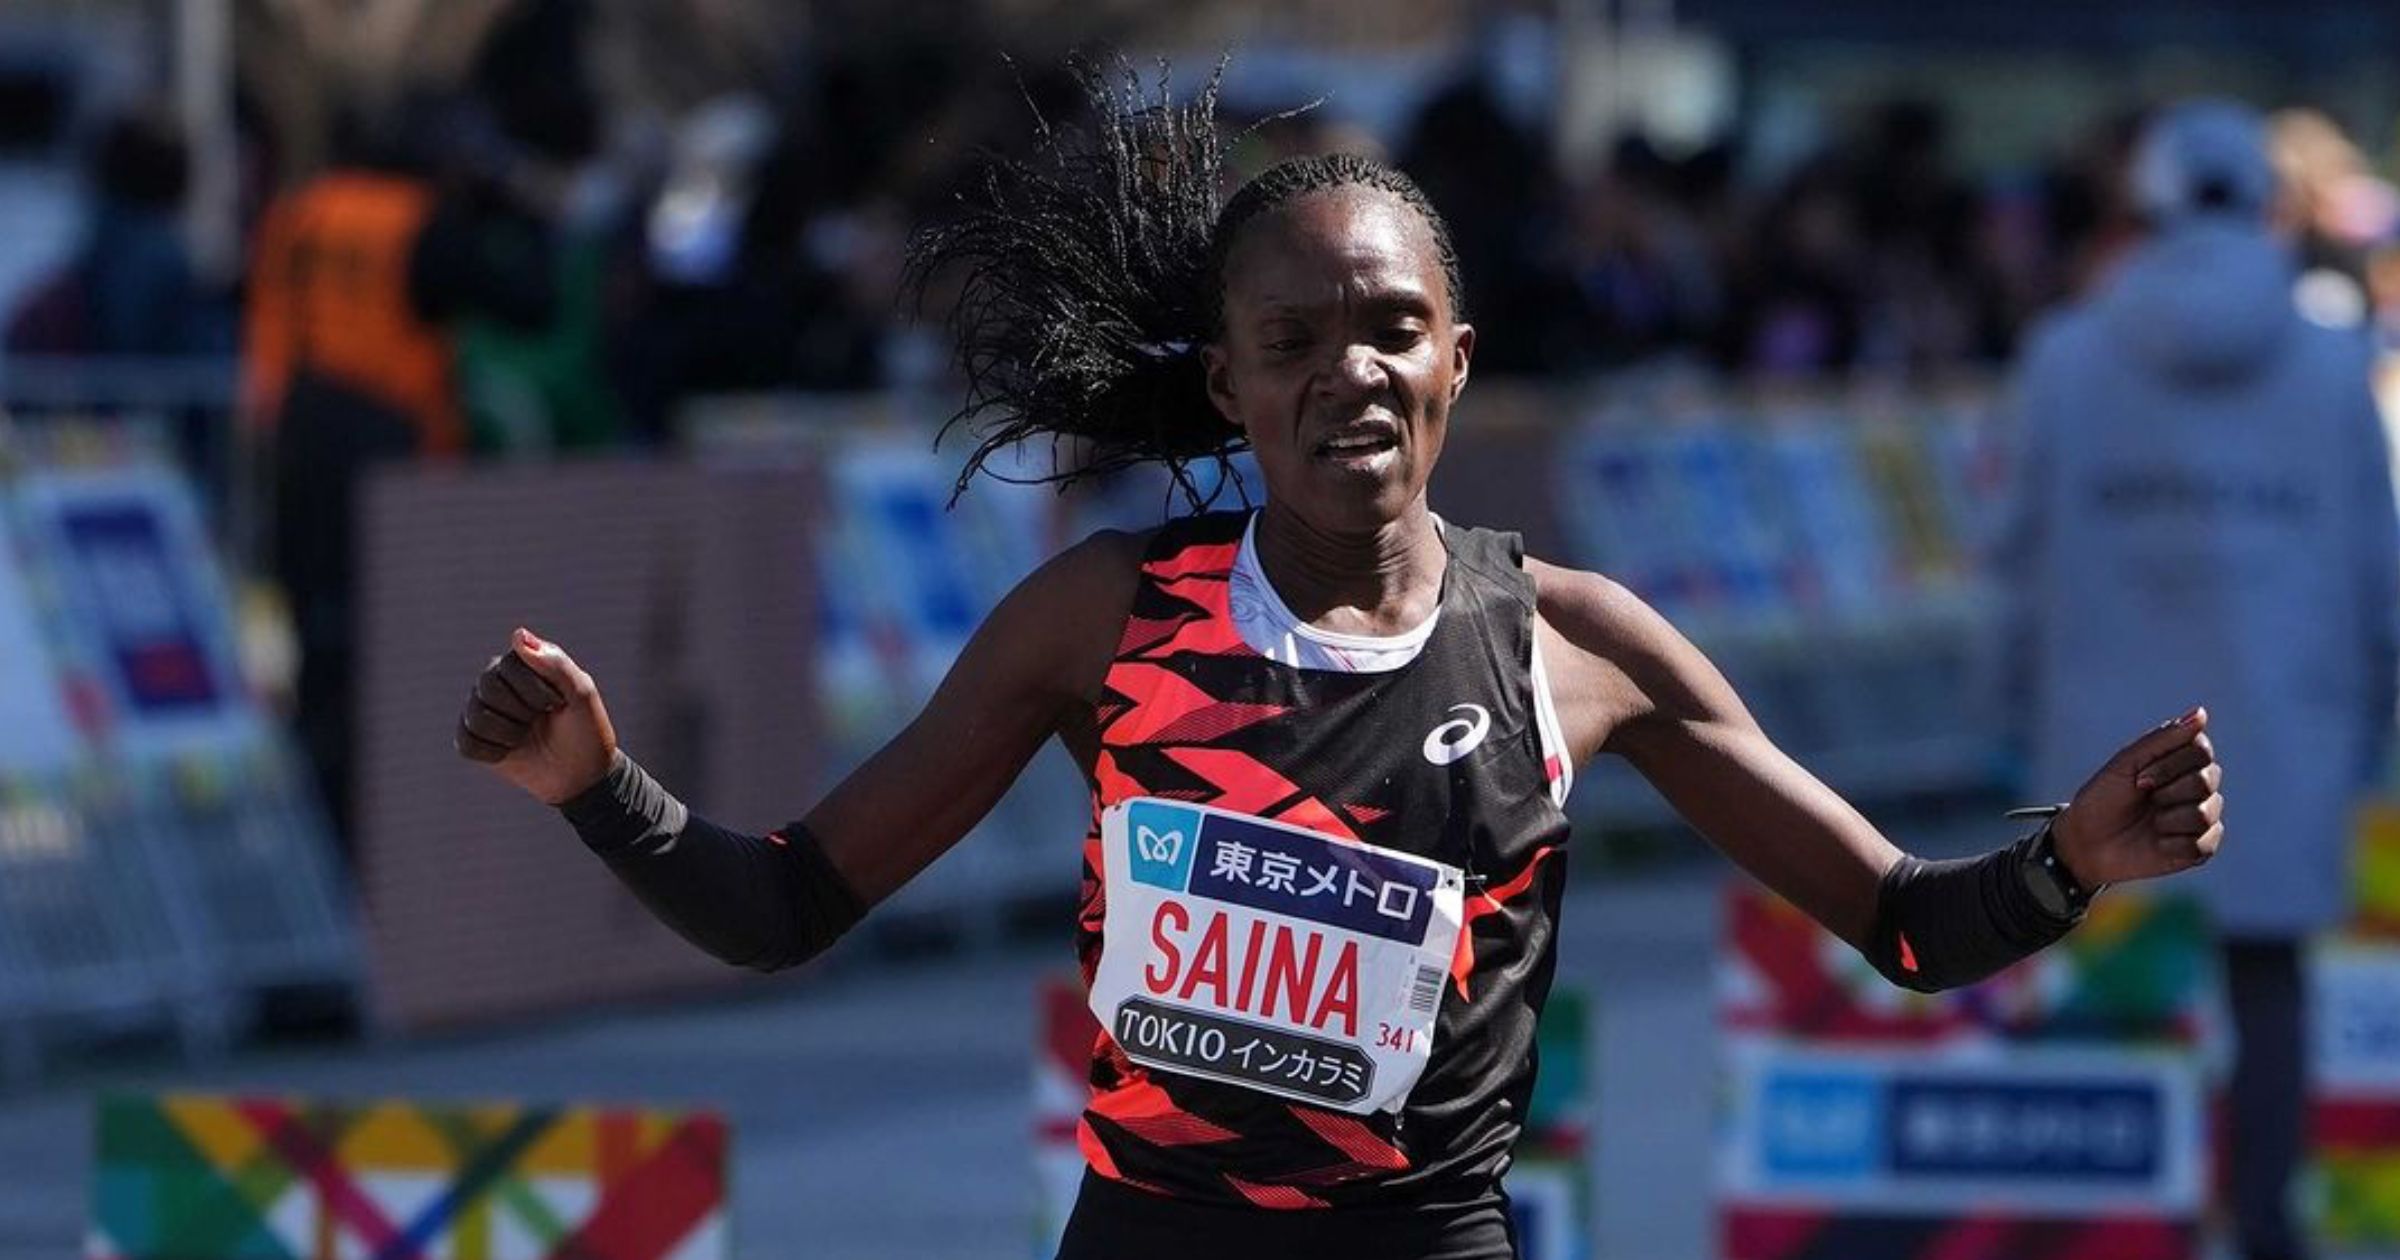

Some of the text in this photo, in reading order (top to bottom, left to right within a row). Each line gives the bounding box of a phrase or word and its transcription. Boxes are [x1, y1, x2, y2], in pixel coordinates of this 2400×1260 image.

[1211, 841, 1418, 920] 東京メトロ
[1145, 900, 1358, 1037] SAINA
[1121, 1009, 1363, 1092] TOKIO インカラミ
[1375, 1022, 1414, 1053] 341
